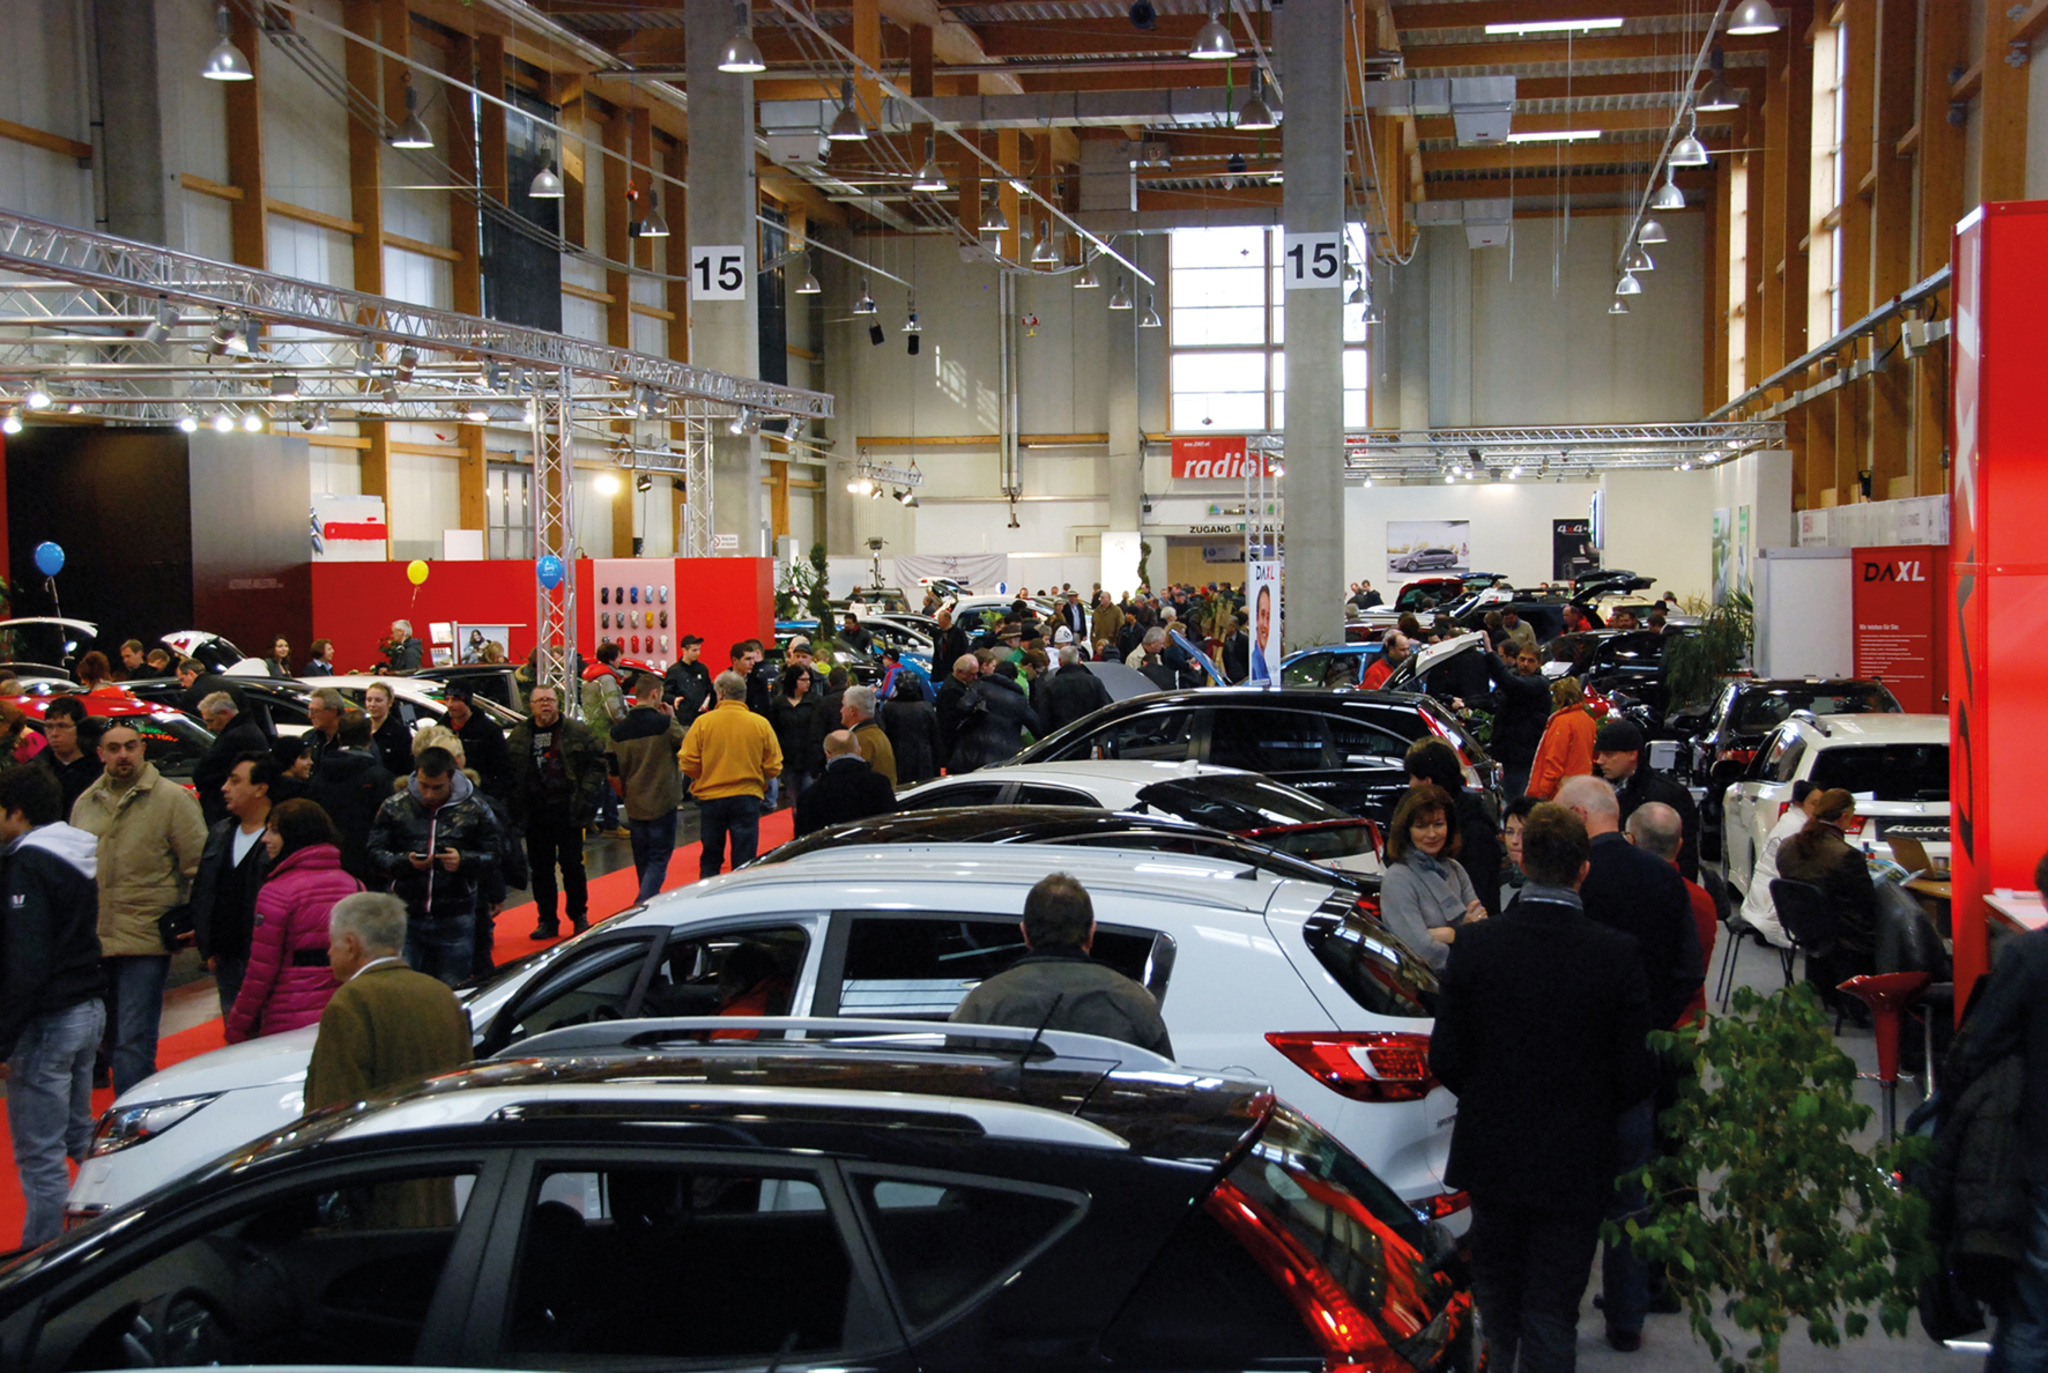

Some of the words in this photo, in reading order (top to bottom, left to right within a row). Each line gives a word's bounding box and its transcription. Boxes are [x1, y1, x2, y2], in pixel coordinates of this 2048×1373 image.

[1287, 243, 1338, 279] 15
[694, 256, 743, 291] 15
[1184, 452, 1257, 478] radio
[1189, 525, 1232, 534] ZUGANG
[1256, 565, 1275, 580] DAXL
[1862, 561, 1926, 582] DAXL
